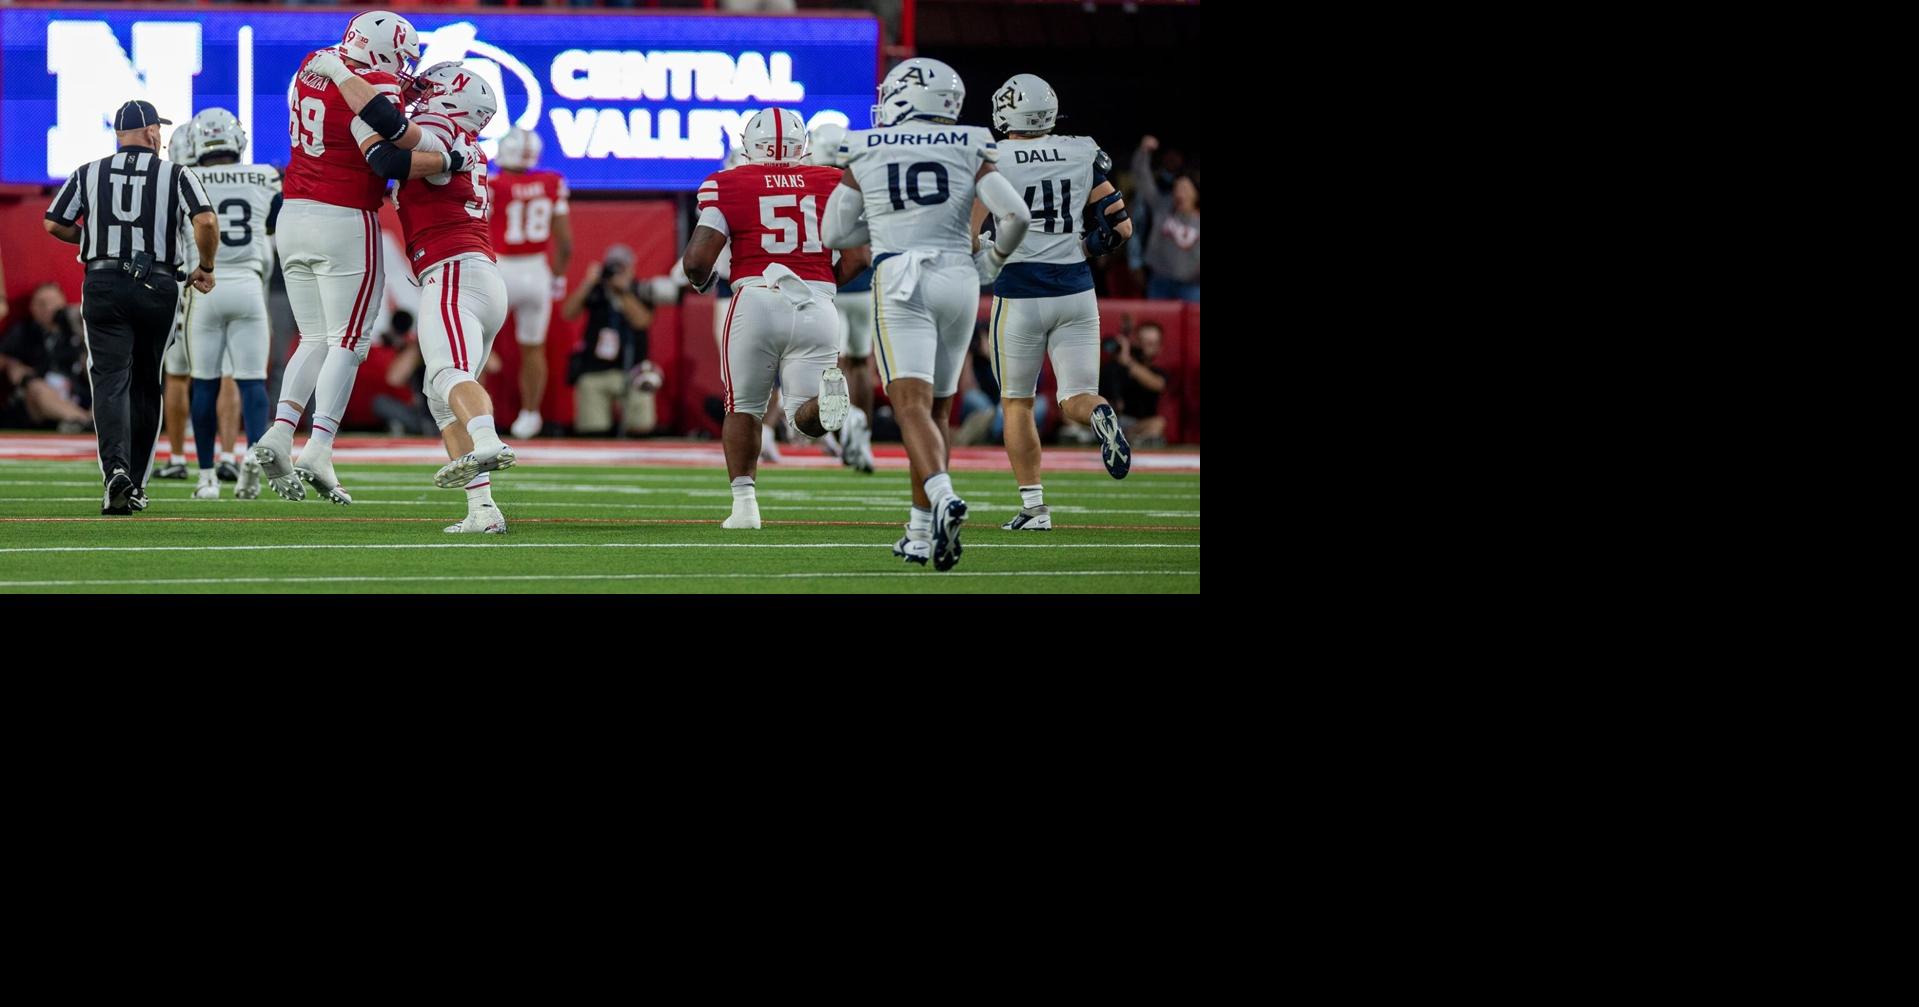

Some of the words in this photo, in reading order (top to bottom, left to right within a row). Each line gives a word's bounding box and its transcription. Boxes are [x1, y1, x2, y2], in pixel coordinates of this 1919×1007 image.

[47, 20, 203, 178] N
[550, 49, 804, 102] CENTRAL
[899, 66, 928, 87] A
[289, 87, 326, 158] 69
[867, 132, 968, 148] DURHAM
[766, 145, 788, 158] 51
[1014, 148, 1067, 164] DALL
[109, 173, 147, 222] U
[202, 171, 266, 187] HUNTER
[463, 162, 488, 220] 5
[764, 174, 805, 189] EVANS
[887, 161, 950, 211] 10
[218, 198, 253, 247] 3
[504, 196, 553, 245] 18
[759, 194, 823, 254] 51
[1023, 178, 1073, 233] 41
